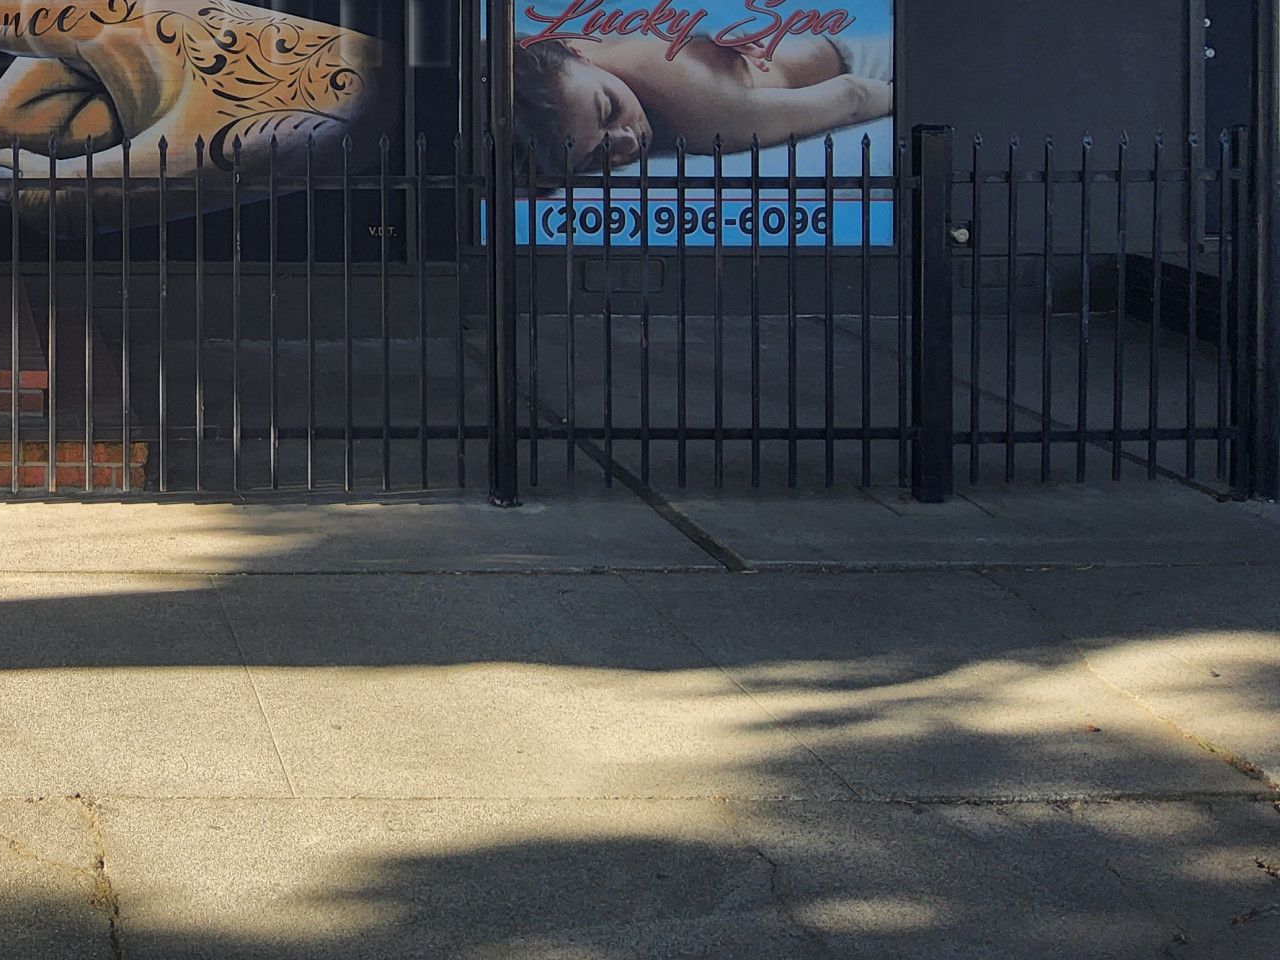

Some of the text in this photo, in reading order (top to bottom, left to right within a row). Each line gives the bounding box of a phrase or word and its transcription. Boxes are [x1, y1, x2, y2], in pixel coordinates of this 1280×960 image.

[368, 226, 398, 237] V.T.
[540, 205, 828, 240] (209) 996-6096
